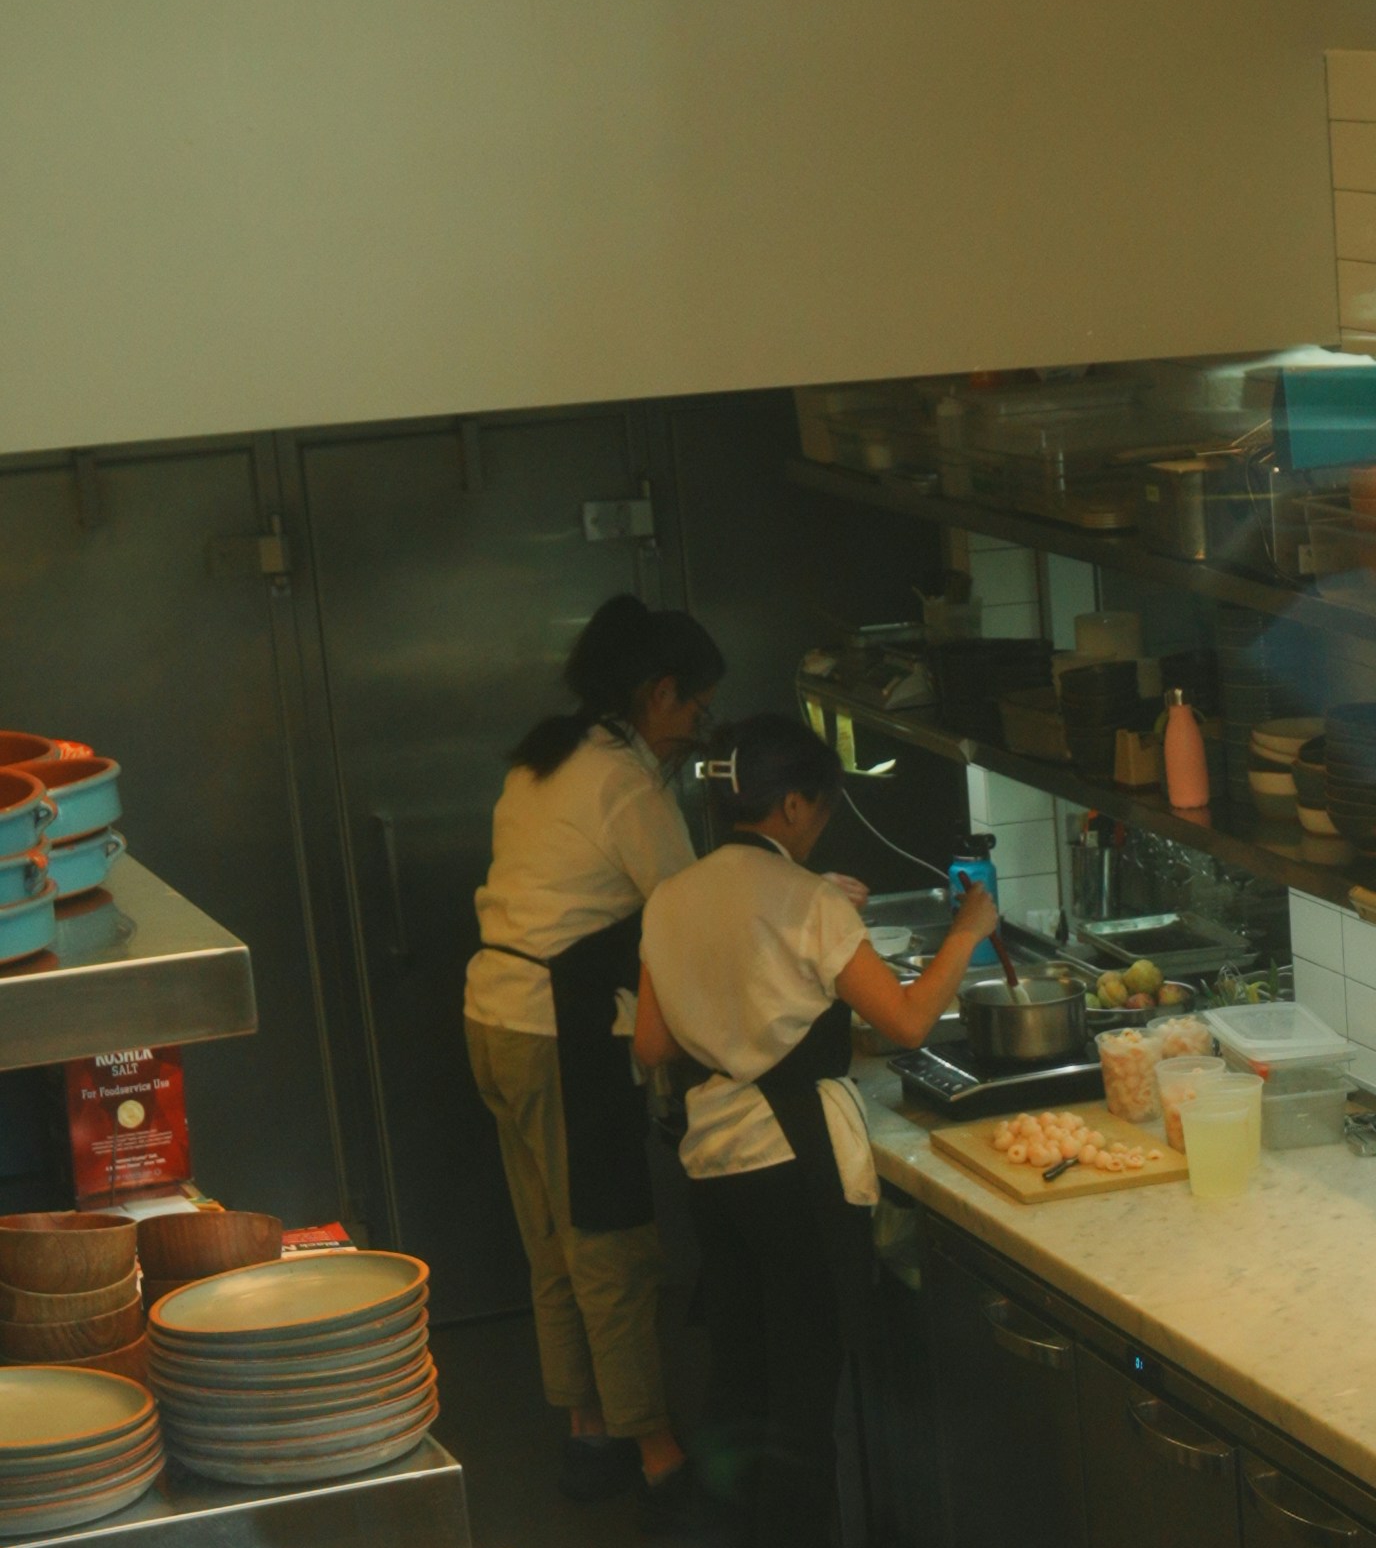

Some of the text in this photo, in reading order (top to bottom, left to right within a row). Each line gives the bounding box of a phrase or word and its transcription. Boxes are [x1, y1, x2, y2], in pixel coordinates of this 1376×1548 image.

[112, 1063, 139, 1076] SALT
[82, 1078, 170, 1100] For Foodservice Use
